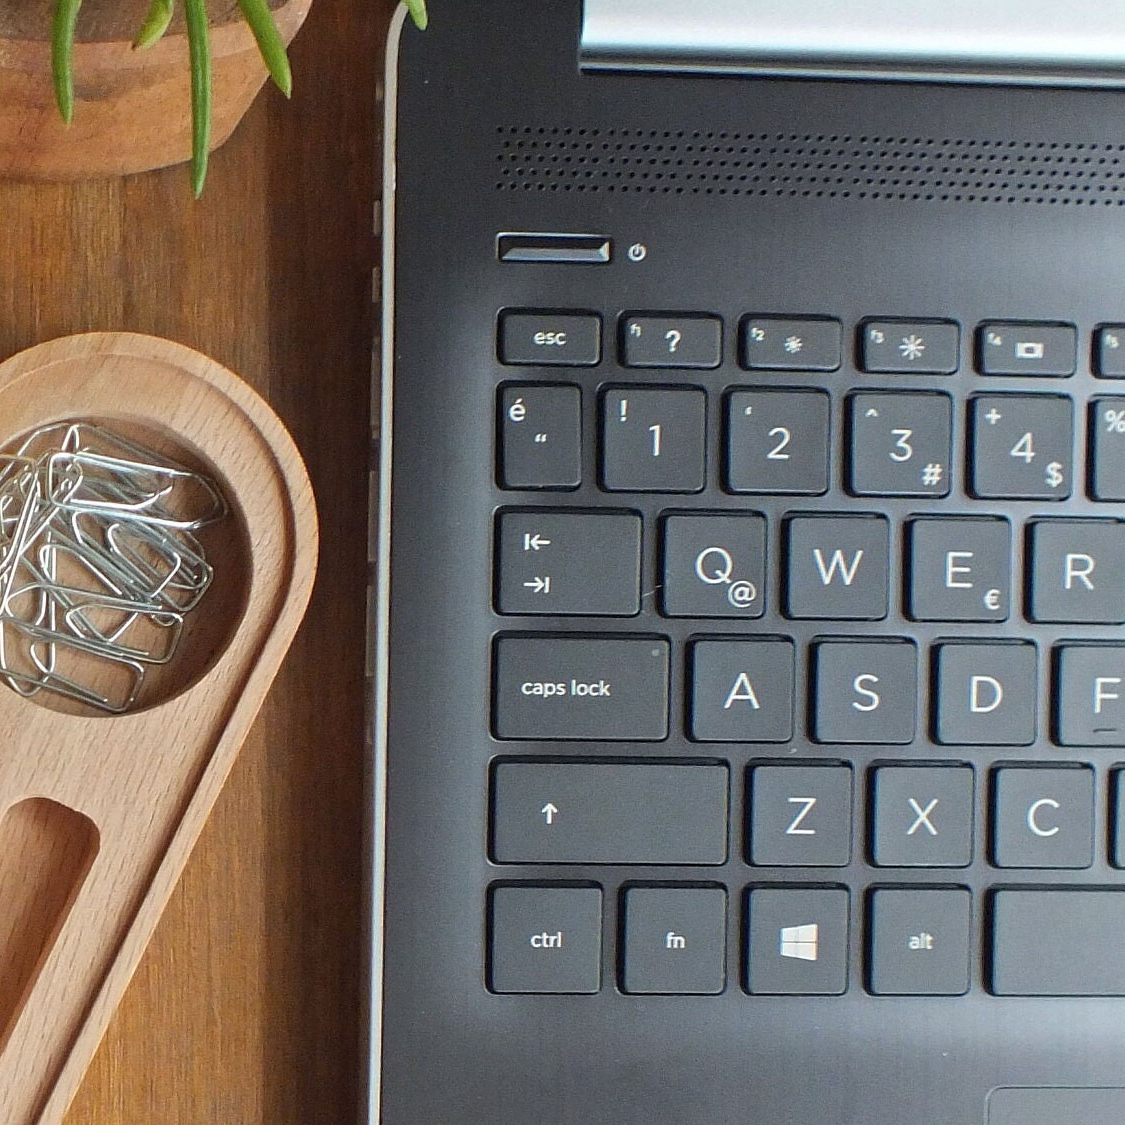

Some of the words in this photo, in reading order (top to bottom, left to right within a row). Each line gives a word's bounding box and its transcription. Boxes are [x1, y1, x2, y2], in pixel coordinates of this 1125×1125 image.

[534, 333, 566, 345] esc
[666, 330, 680, 351] ?
[752, 328, 764, 340] f2
[871, 330, 884, 343] f3
[510, 399, 525, 421] é
[621, 400, 627, 421] !
[986, 409, 1001, 424] +
[649, 425, 660, 456] 1
[767, 428, 790, 459] 2
[890, 430, 912, 461] 3
[1011, 433, 1035, 462] 4
[922, 464, 942, 485] #
[1047, 462, 1062, 487] $
[695, 547, 732, 585] Q
[814, 549, 863, 585] W
[947, 552, 973, 587] E
[1065, 554, 1094, 589] R
[727, 580, 757, 608] @
[984, 589, 999, 609] €
[522, 683, 566, 697] caps
[572, 680, 610, 696] lock
[725, 673, 759, 708] A
[853, 675, 879, 711] S
[971, 676, 1002, 712] D
[1095, 678, 1121, 713] F
[786, 798, 816, 834] Z
[907, 799, 938, 835] X
[1028, 799, 1059, 836] C
[531, 932, 561, 947] ctrl
[667, 932, 685, 948] fn
[909, 933, 932, 949] alt
